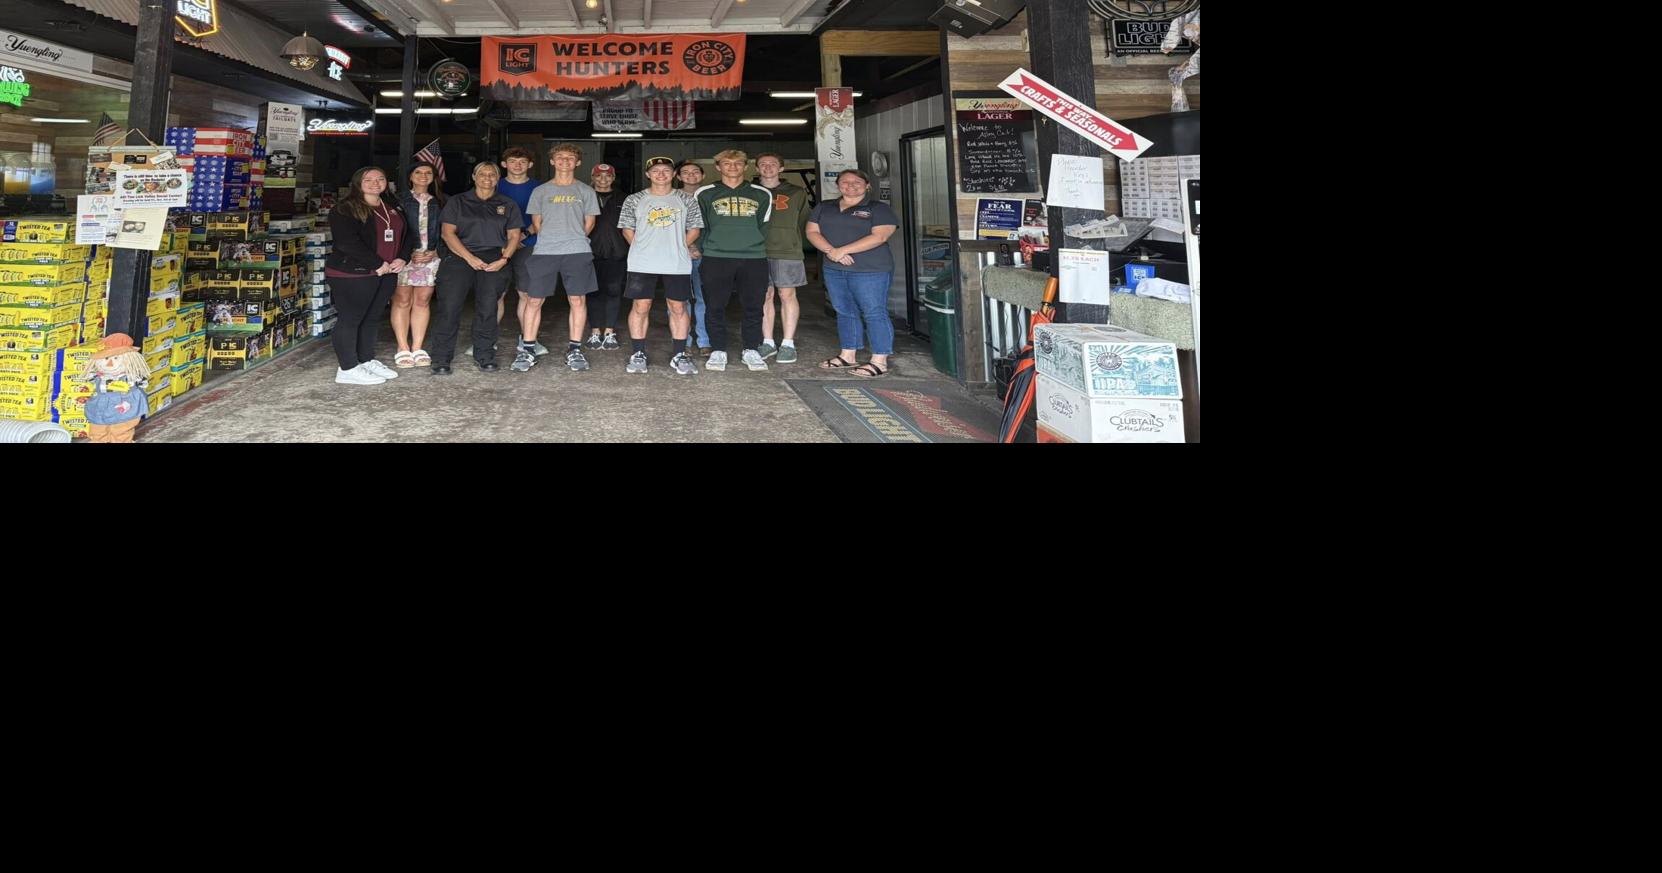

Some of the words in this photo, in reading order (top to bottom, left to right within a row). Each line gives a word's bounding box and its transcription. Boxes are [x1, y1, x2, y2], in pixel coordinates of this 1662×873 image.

[177, 0, 211, 24] LIGHT
[1126, 22, 1171, 34] BUD
[1118, 33, 1170, 45] LIGH
[5, 34, 63, 61] Yuengling
[506, 48, 530, 62] IC
[552, 41, 673, 57] WELCOME
[685, 40, 711, 59] IRON
[713, 40, 734, 60] CITY
[556, 60, 671, 76] HUNTERS
[692, 63, 727, 74] BEER
[832, 89, 840, 108] LAGER
[968, 100, 1020, 110] Yuengling
[1056, 98, 1074, 110] THIS
[1020, 85, 1055, 109] CRAFTS
[1055, 105, 1064, 114] &
[1064, 109, 1123, 146] SEASONALS
[307, 119, 374, 132] Yuengling
[830, 127, 844, 160] Yuengling
[67, 351, 89, 359] TWISTED
[856, 408, 924, 443] LIGH
[1110, 416, 1164, 428] CLUBTAILS
